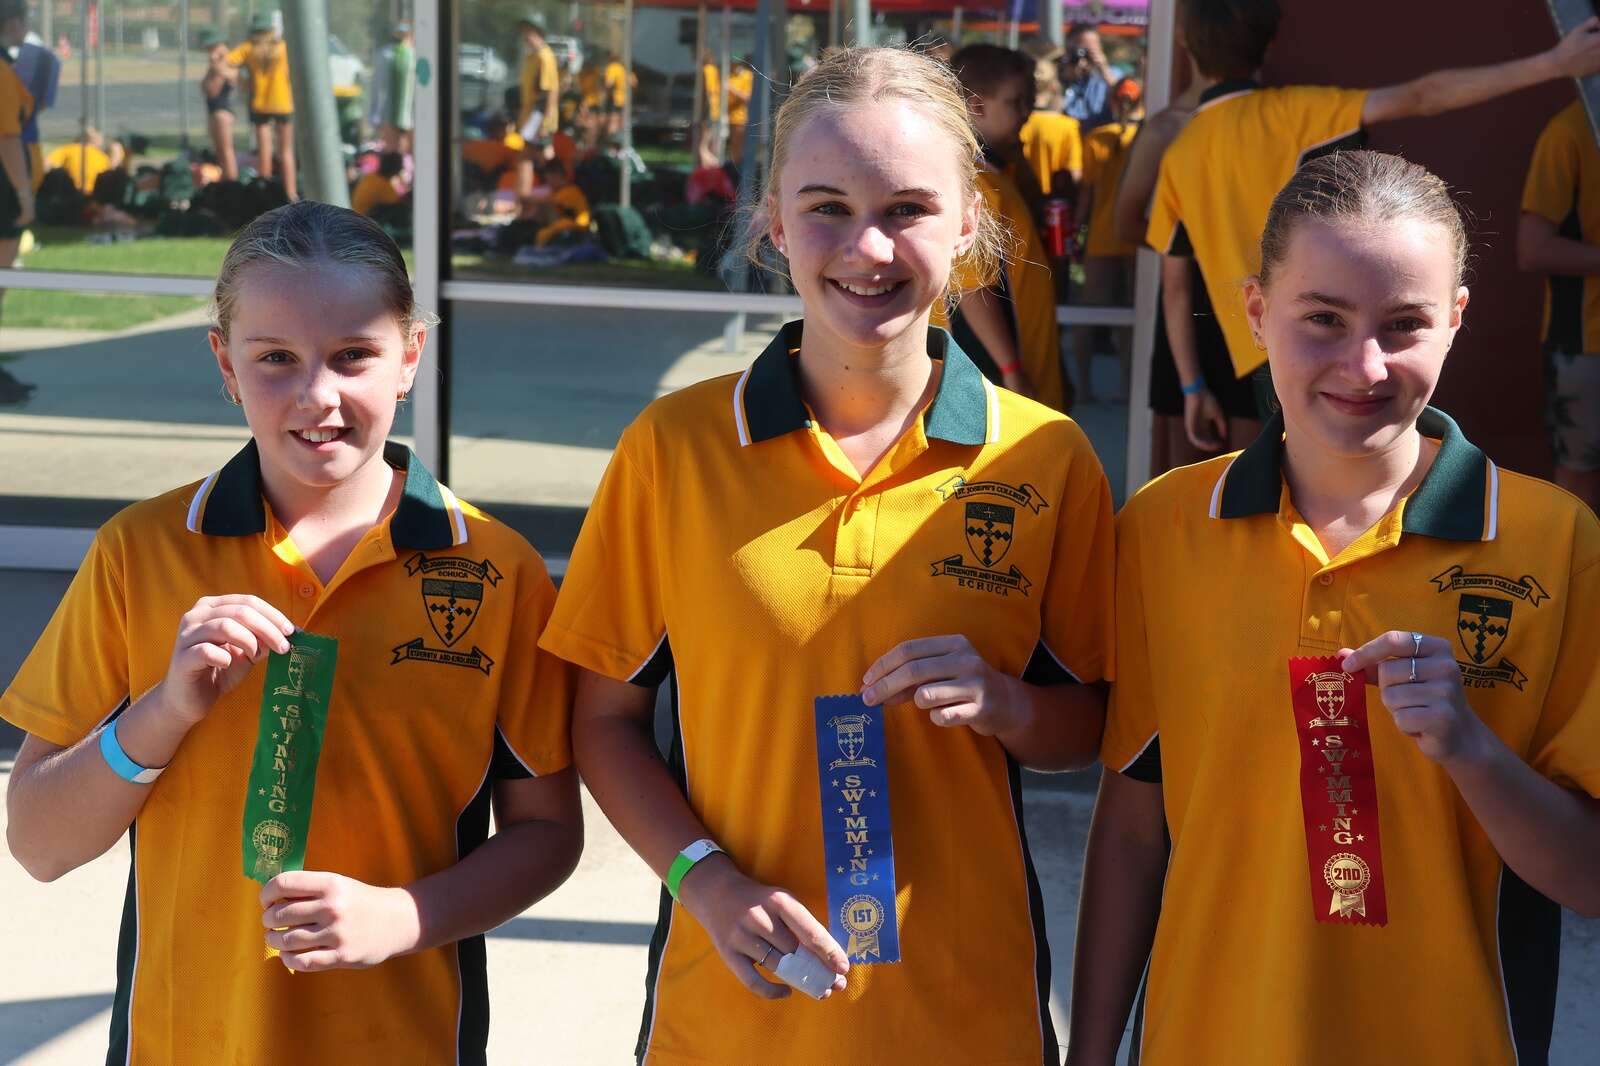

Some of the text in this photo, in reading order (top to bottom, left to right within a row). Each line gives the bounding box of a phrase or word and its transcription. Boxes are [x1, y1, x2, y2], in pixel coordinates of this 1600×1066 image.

[996, 485, 1026, 503] COLLEGE
[958, 577, 1009, 597] ECHUCA
[1464, 678, 1496, 689] HUCA
[1321, 734, 1354, 845] SWIMMING
[841, 774, 869, 886] SWIMMING
[261, 833, 286, 849] 3RD
[1333, 867, 1361, 881] 2ND
